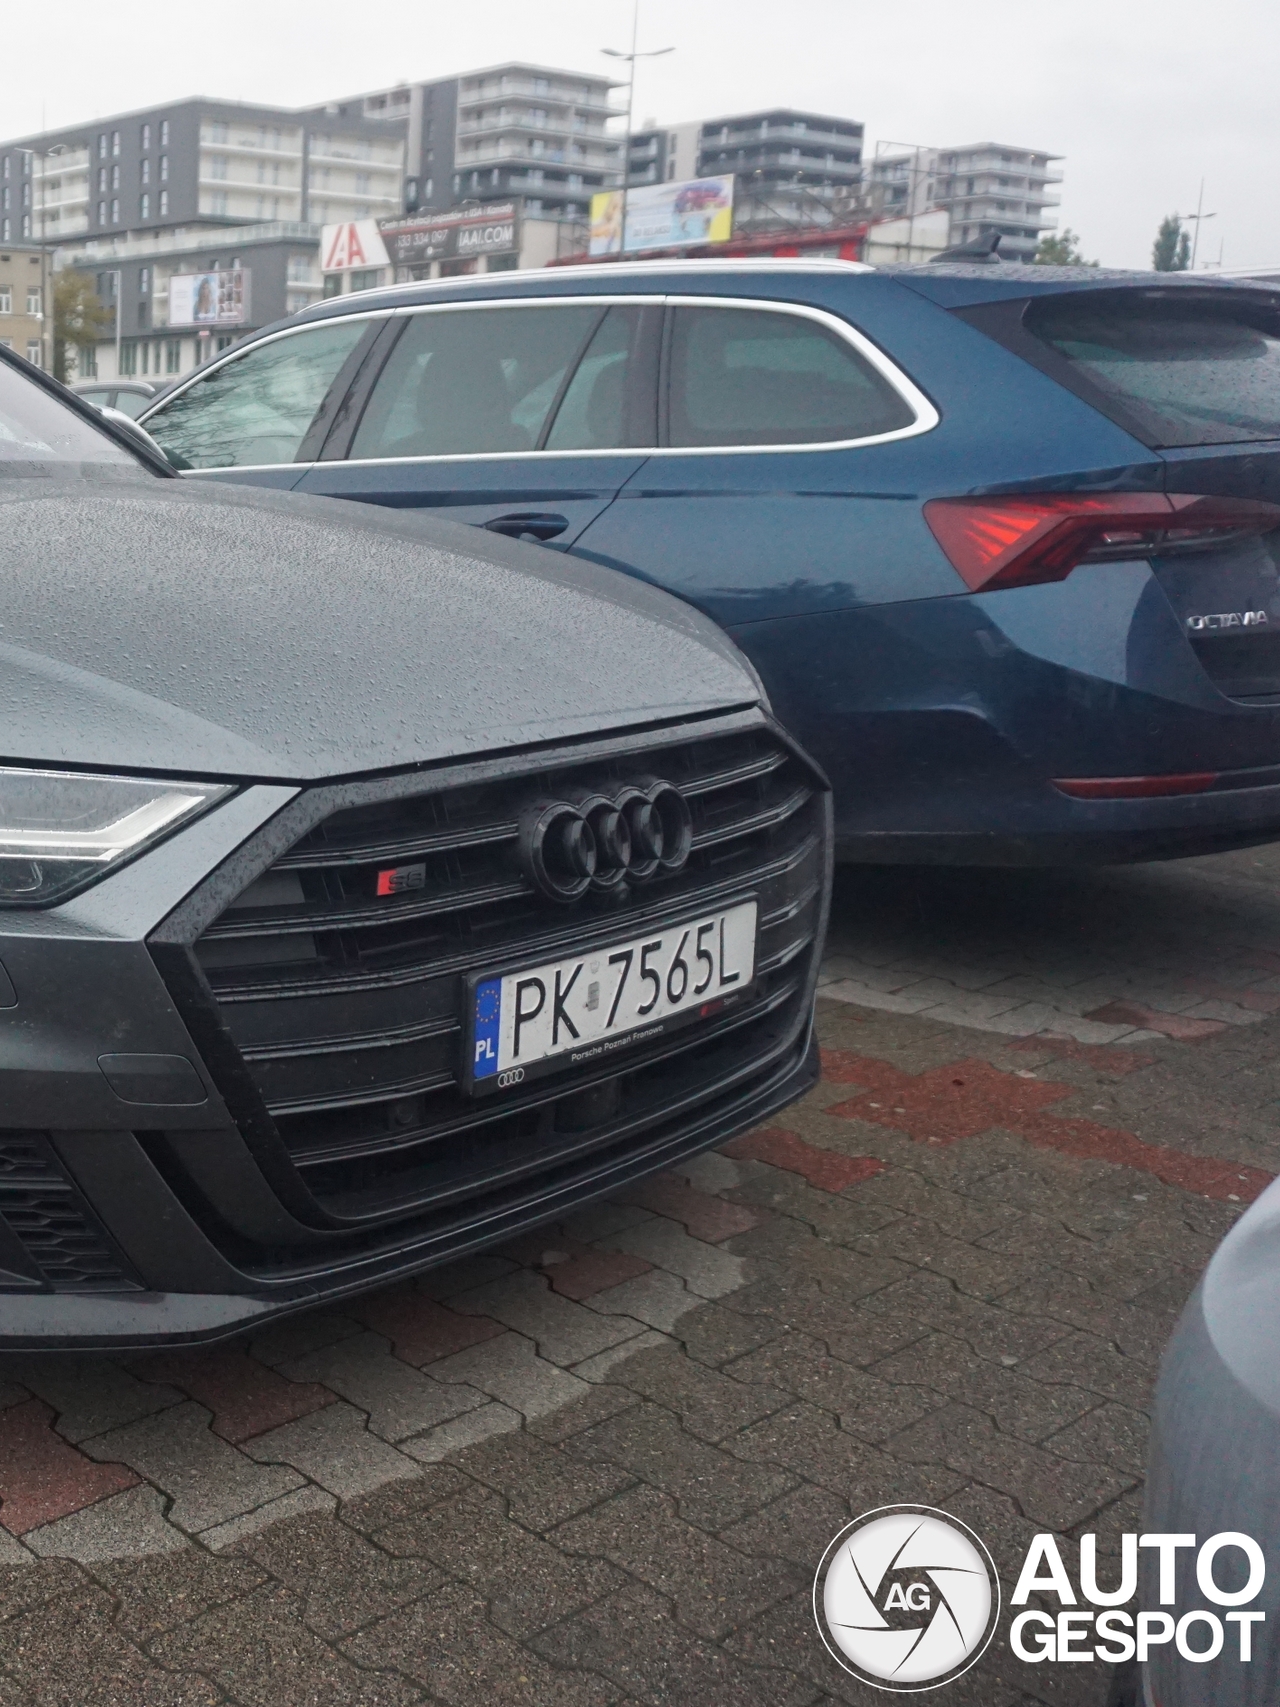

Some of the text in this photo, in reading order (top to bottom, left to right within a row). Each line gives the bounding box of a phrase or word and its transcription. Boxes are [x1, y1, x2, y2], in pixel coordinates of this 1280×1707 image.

[1186, 610, 1268, 630] OCTAVIA
[512, 915, 740, 1058] PK 7565L
[475, 1037, 495, 1062] PL
[571, 1024, 664, 1062] Porsche Poznań Franowo
